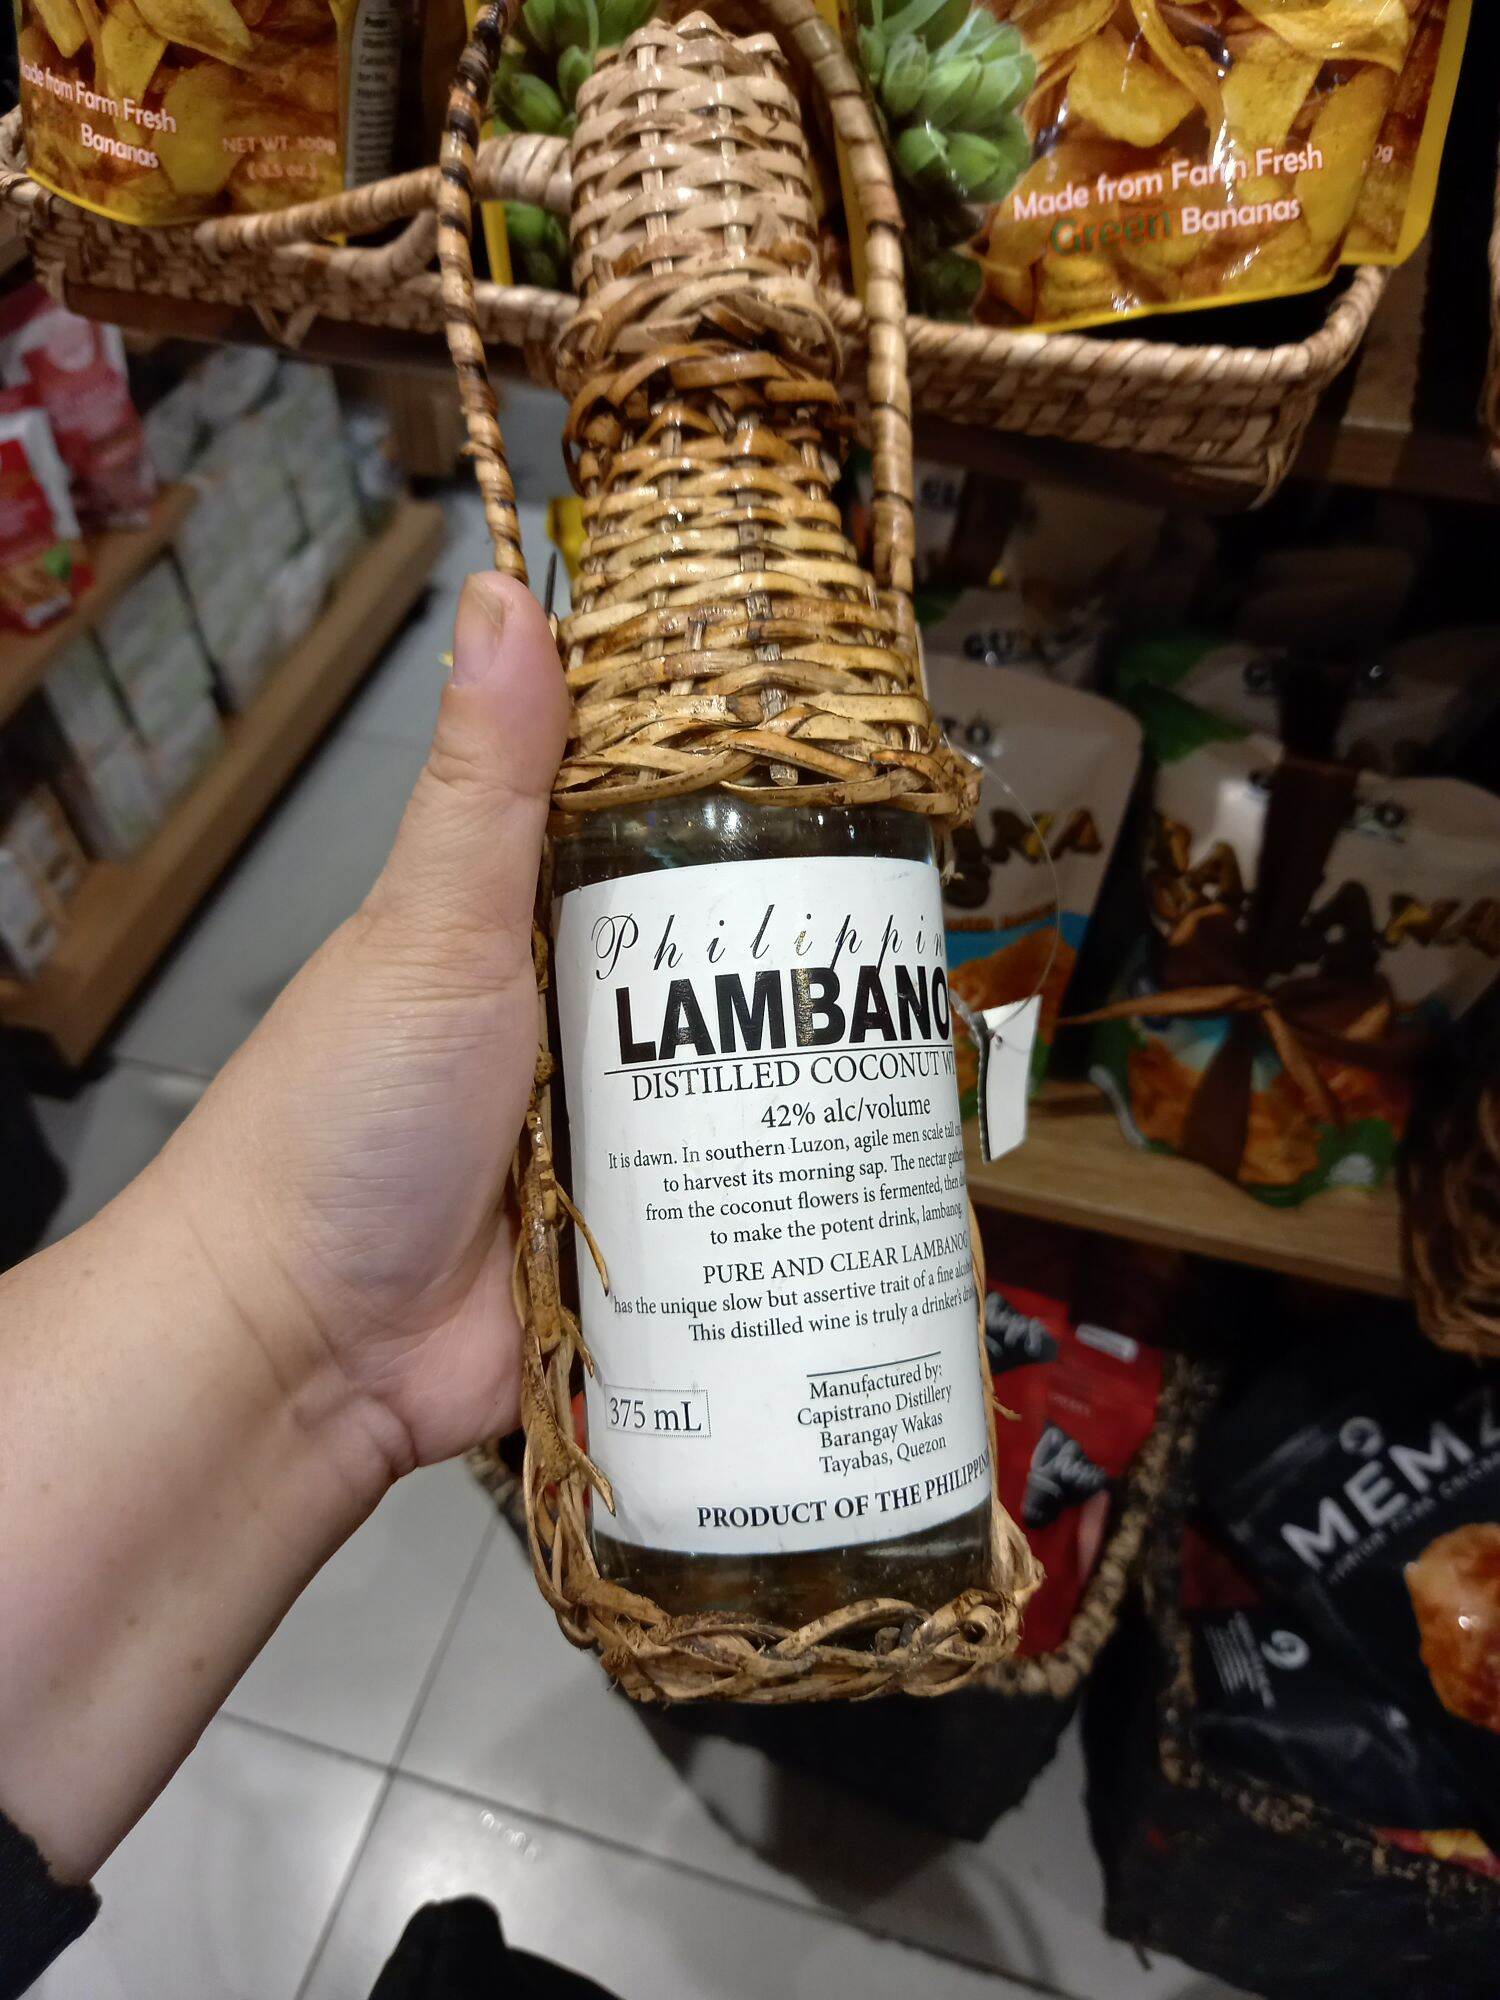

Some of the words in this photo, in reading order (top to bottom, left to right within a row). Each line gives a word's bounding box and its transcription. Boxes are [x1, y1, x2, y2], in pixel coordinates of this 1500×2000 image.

[21, 60, 44, 87] ade
[45, 67, 74, 100] from
[75, 81, 118, 117] Farm
[123, 97, 177, 133] Fresh
[81, 123, 160, 168] Bananas
[1013, 185, 1091, 221] Made
[1097, 174, 1163, 202] from
[1171, 159, 1248, 187] Farm
[1256, 144, 1323, 177] Fresh
[1051, 209, 1173, 256] Green
[1181, 199, 1301, 236] Bananas
[632, 1060, 800, 1102] DISTILLED
[810, 1051, 939, 1086] COCONUT
[761, 1102, 816, 1128] 42%
[823, 1094, 932, 1124] alc/volume
[608, 1152, 618, 1169] It
[620, 1153, 631, 1168] is
[633, 1150, 678, 1167] dawn.
[682, 1146, 700, 1163] In
[705, 1141, 786, 1161] southern
[790, 1136, 850, 1154] Luzon,
[854, 1129, 889, 1152] agile
[892, 1130, 920, 1145] men
[922, 1122, 943, 1141] scale
[944, 1120, 954, 1138] tall
[663, 1177, 679, 1192] to
[683, 1171, 748, 1191] harvest
[752, 1169, 774, 1186] its
[779, 1163, 855, 1182] morning
[859, 1161, 888, 1179] sap.
[891, 1154, 916, 1171] The
[918, 1152, 947, 1169] nectar
[646, 1203, 683, 1221] from
[688, 1200, 715, 1218] the
[720, 1195, 793, 1216] coconut
[798, 1190, 859, 1209] flowers
[863, 1186, 876, 1203] is
[880, 1175, 943, 1201] fermented,
[944, 1173, 959, 1191] then
[710, 1229, 728, 1245] to
[733, 1222, 782, 1243] make
[787, 1219, 816, 1238] the
[821, 1215, 874, 1240] potent
[878, 1207, 920, 1229] drink,
[703, 1261, 765, 1285] PURE
[771, 1256, 824, 1279] AND
[830, 1246, 899, 1273] CLEAR
[902, 1230, 968, 1263] LAMBANOG
[614, 1295, 633, 1314] has
[635, 1295, 657, 1315] the
[660, 1297, 718, 1319] unique
[722, 1292, 763, 1312] slow
[767, 1289, 799, 1308] but
[803, 1281, 876, 1305] assertive
[880, 1274, 910, 1295] trait
[913, 1269, 926, 1288] of
[928, 1273, 935, 1286] a
[937, 1265, 954, 1283] fine
[688, 1323, 726, 1342] This
[730, 1315, 805, 1340] distilled
[808, 1313, 851, 1332] wine
[856, 1309, 868, 1327] is
[872, 1303, 908, 1325] truly
[911, 1304, 919, 1317] a
[809, 1363, 922, 1399] Manufactured
[924, 1362, 943, 1383] by:
[610, 1396, 646, 1430] 375
[653, 1401, 702, 1432] mL
[797, 1401, 891, 1429] Capistrano
[895, 1384, 952, 1412] Distillery
[820, 1423, 899, 1449] Barangay
[901, 1411, 943, 1435] Wakas
[819, 1449, 893, 1477] Tayabas,
[896, 1436, 947, 1462] Quezon
[696, 1499, 828, 1528] PRODUCT
[834, 1494, 870, 1519] OF
[875, 1482, 922, 1513] THE
